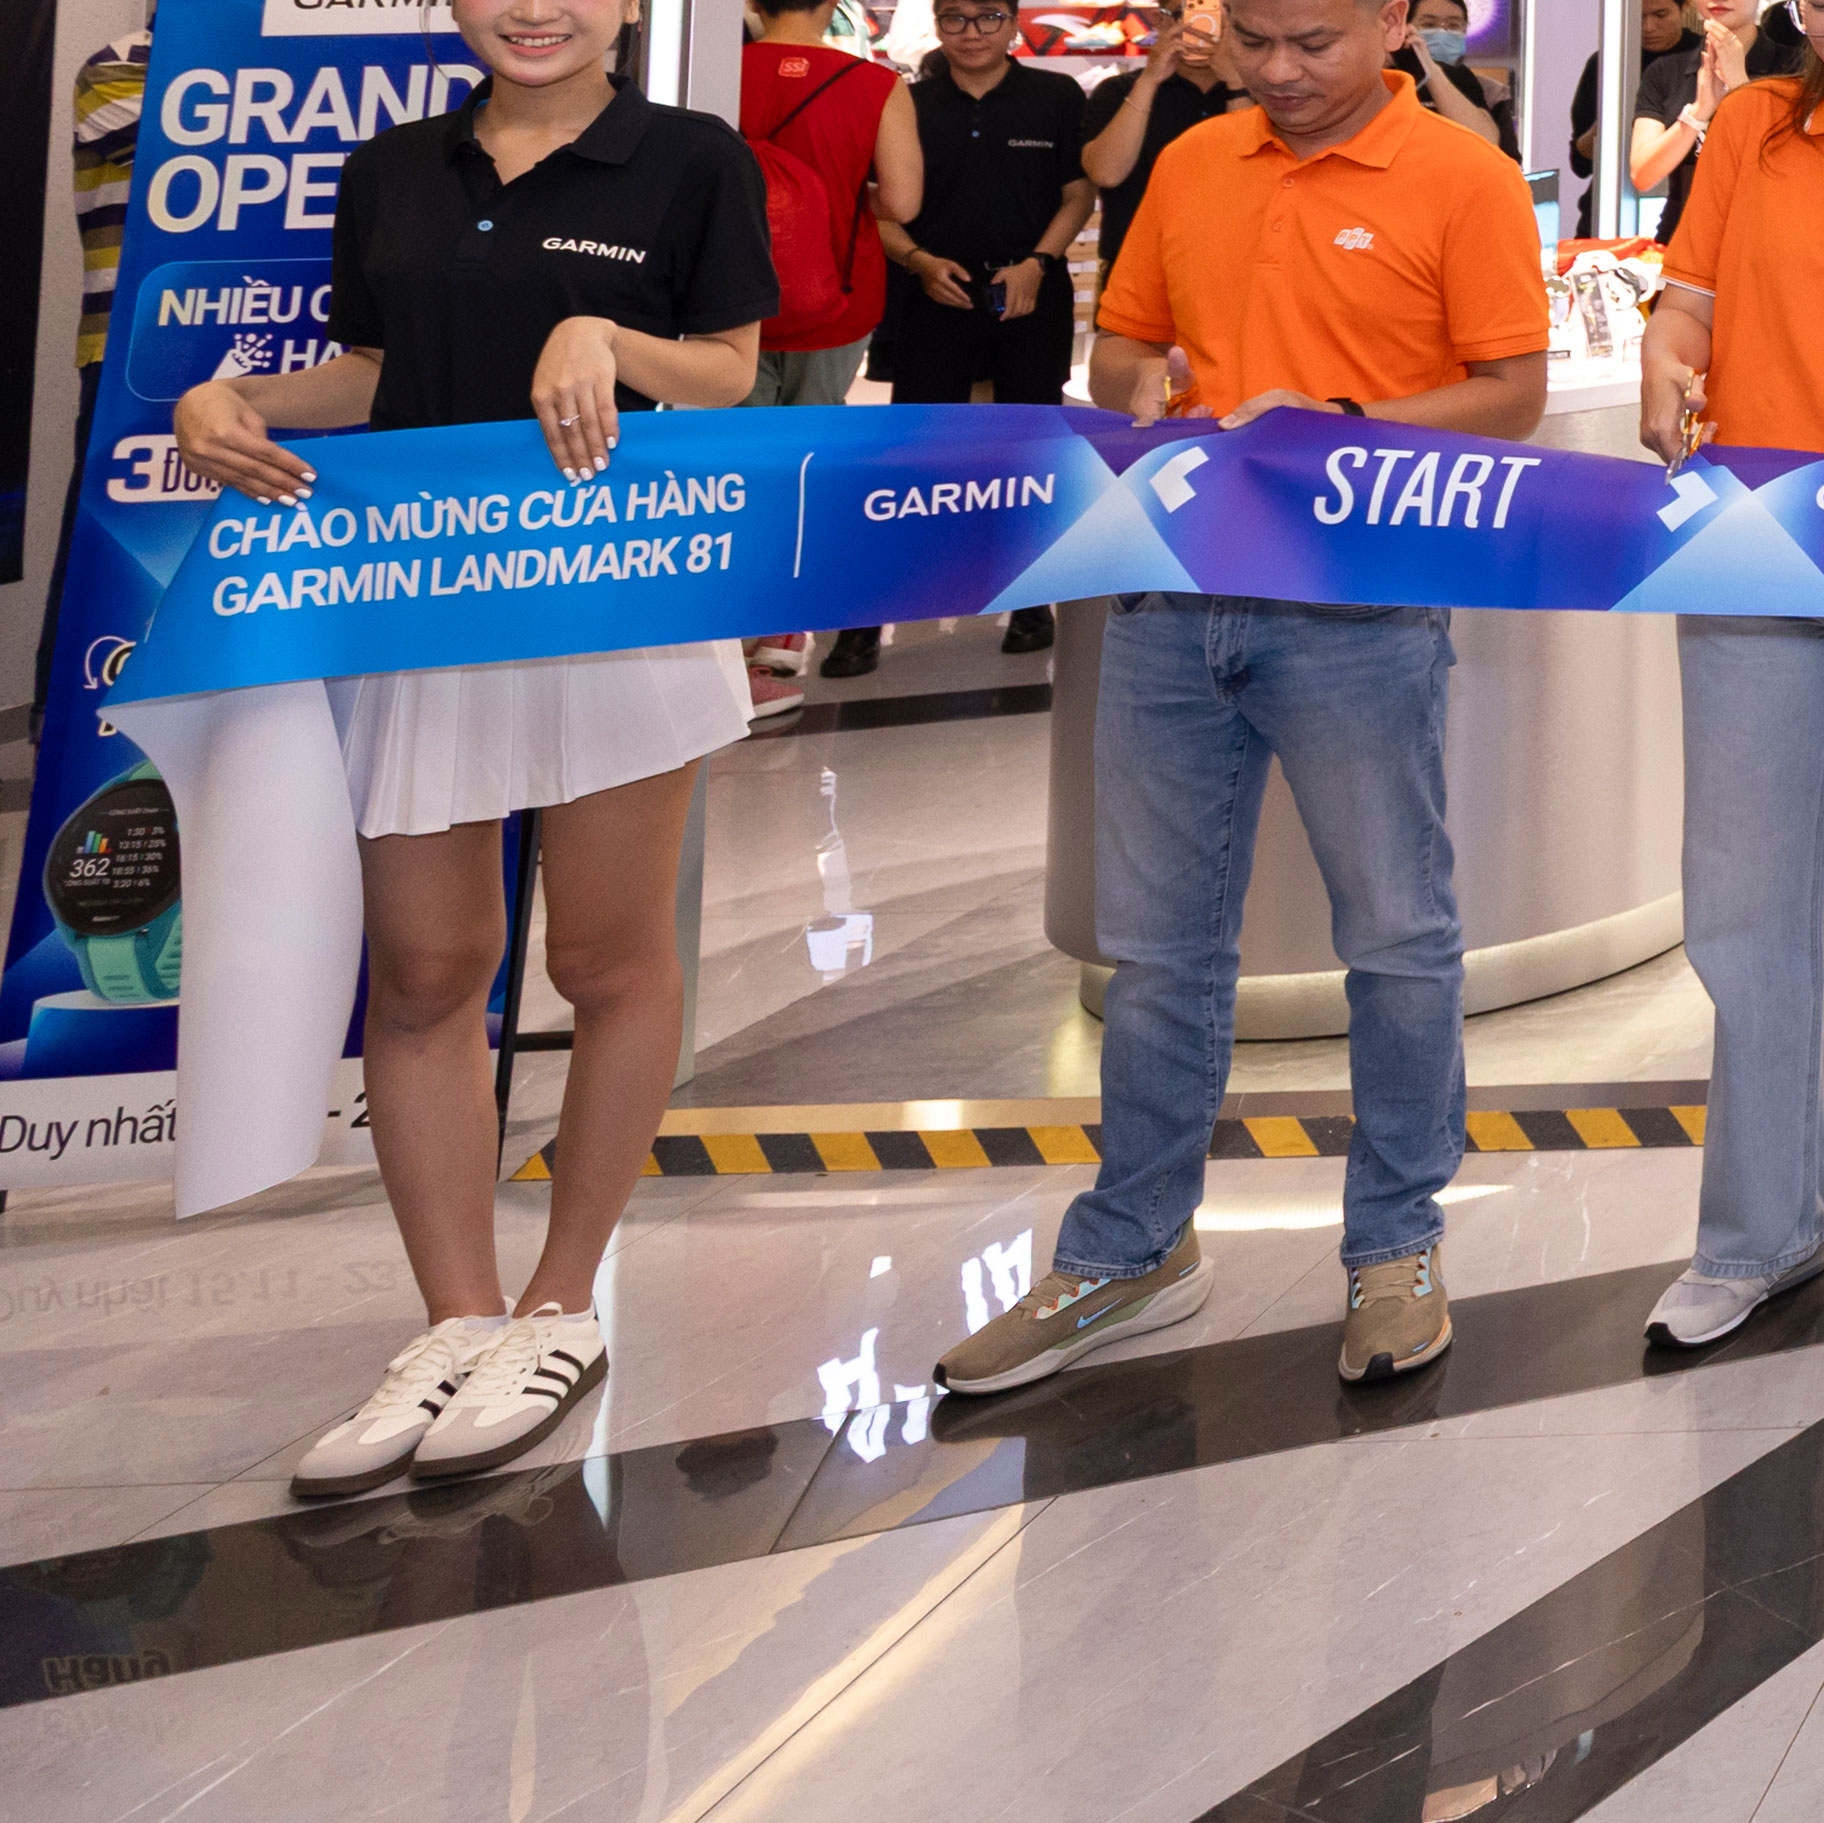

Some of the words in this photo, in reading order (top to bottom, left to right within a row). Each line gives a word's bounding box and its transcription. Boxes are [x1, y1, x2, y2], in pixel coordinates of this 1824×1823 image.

[1008, 138, 1054, 149] GARMIN
[542, 237, 646, 264] GARMIN
[157, 276, 303, 327] NHIỀU
[863, 472, 1056, 523] GARMIN
[1313, 445, 1543, 530] START
[206, 502, 358, 560] CHÀO
[367, 490, 511, 545] MỪNG
[516, 477, 616, 532] CỬA
[626, 470, 747, 524] HÀNG
[211, 559, 422, 617] GARMIN
[430, 536, 682, 598] LANDMARK
[686, 531, 734, 575] 81
[69, 857, 111, 878] 362
[0, 1113, 78, 1161] Duy
[85, 1098, 178, 1148] nhất
